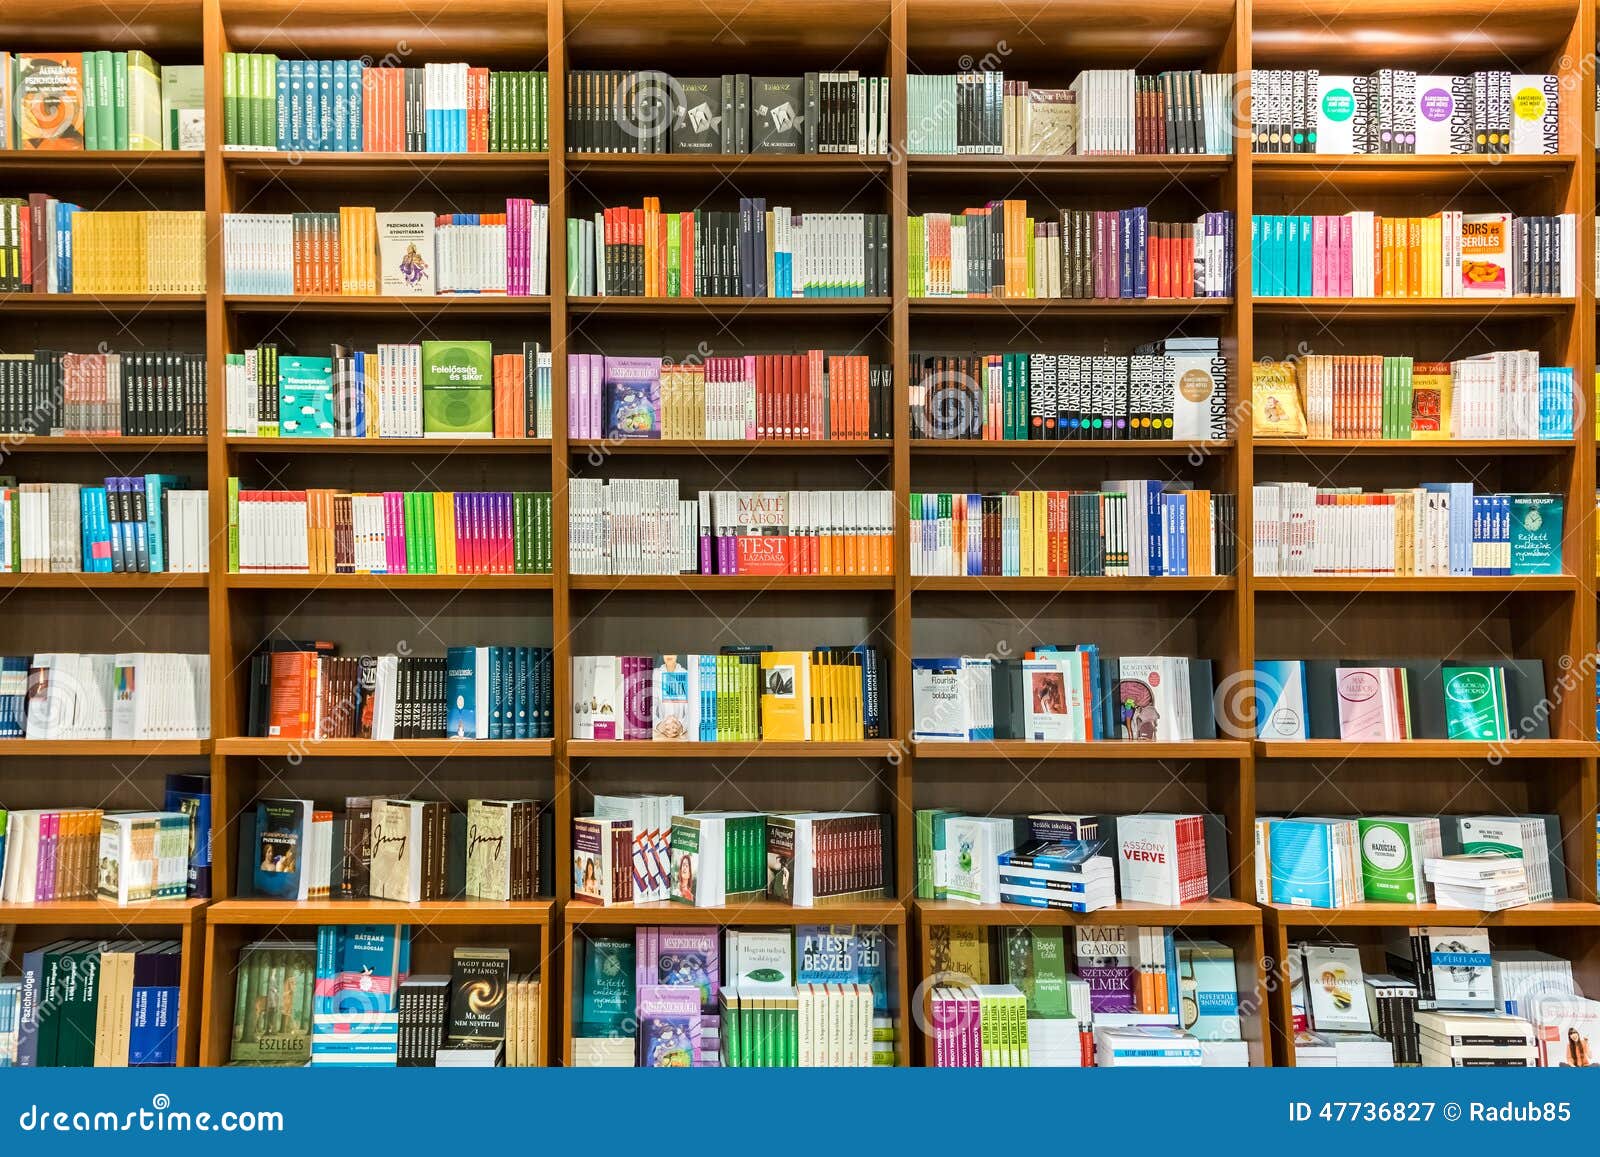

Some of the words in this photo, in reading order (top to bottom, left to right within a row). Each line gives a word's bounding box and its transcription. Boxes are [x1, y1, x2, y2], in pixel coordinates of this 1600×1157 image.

[1461, 234, 1500, 248] SÉRÜLÉS
[1462, 222, 1488, 235] SORS
[1490, 226, 1500, 235] és
[431, 365, 477, 378] Felelősség
[450, 373, 461, 381] és
[462, 372, 483, 381] siker
[1032, 353, 1043, 416] RANSCHBURG
[1045, 356, 1056, 417] RANSCHBURG
[1059, 355, 1069, 411] RANSCHBURG
[1070, 356, 1080, 411] RANSCHBURG
[1081, 356, 1091, 414] RANSCHBURG
[1093, 356, 1103, 414] RANSCHBURG
[1103, 356, 1114, 416] RANSCHBURG
[1116, 357, 1127, 416] RANSCHBURG
[1131, 356, 1141, 413] RANSCHBURG
[1141, 355, 1151, 413] RANSCHBURG
[1152, 356, 1163, 414] RANSCHBURG
[1164, 356, 1175, 413] RANSCHBURG
[1211, 357, 1227, 440] RANSCHBURG
[739, 496, 785, 511] MÁTÉ
[739, 510, 785, 524] GÁBOR
[743, 538, 787, 554] TEST
[394, 703, 402, 727] SZEX
[373, 823, 407, 860] Jung
[469, 823, 504, 860] Jung
[1123, 841, 1165, 851] ASSZONY
[1123, 850, 1166, 864] VERVE
[804, 936, 814, 952] A
[816, 935, 854, 952] TEST-
[1037, 941, 1056, 952] Bagdy
[1081, 940, 1126, 956] GÁBOR
[477, 967, 498, 975] JÁNOS
[479, 960, 504, 968] EMŐKE
[805, 953, 852, 972] BESZÉD
[22, 970, 35, 1023] Pszichológia
